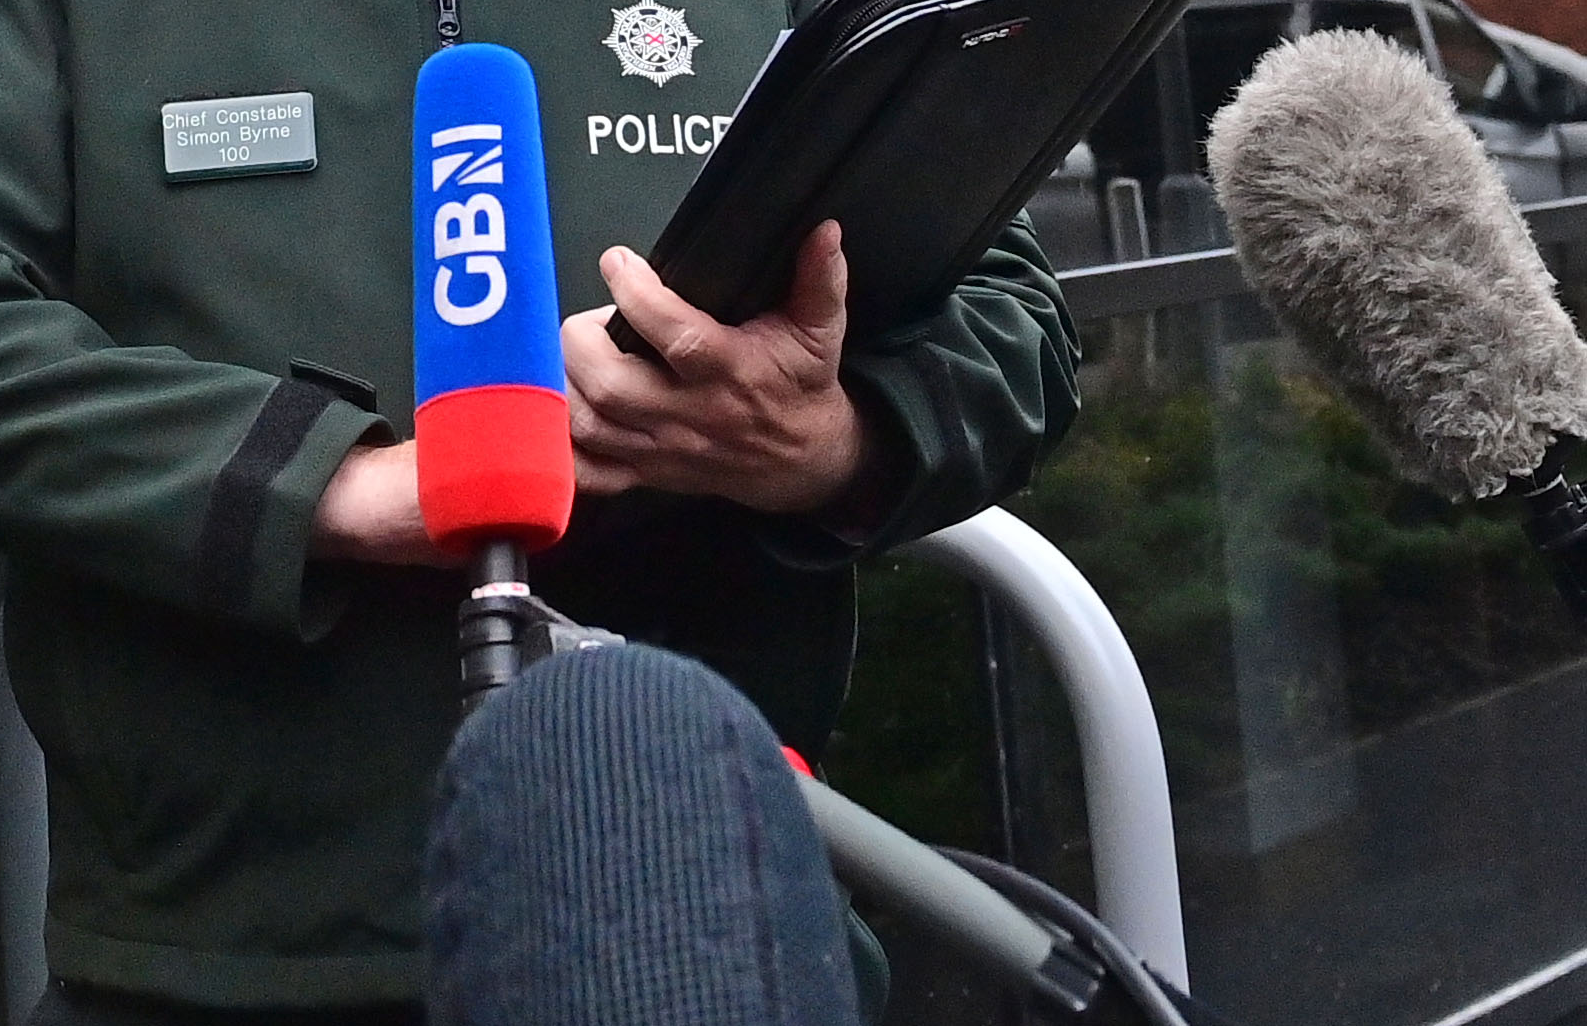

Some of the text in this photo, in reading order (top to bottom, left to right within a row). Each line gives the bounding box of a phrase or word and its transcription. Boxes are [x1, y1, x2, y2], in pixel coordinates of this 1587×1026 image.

[162, 103, 302, 130] Chief Constable
[176, 125, 291, 147] Simon Byrne
[218, 145, 250, 162] 100
[431, 124, 508, 327] GBN
